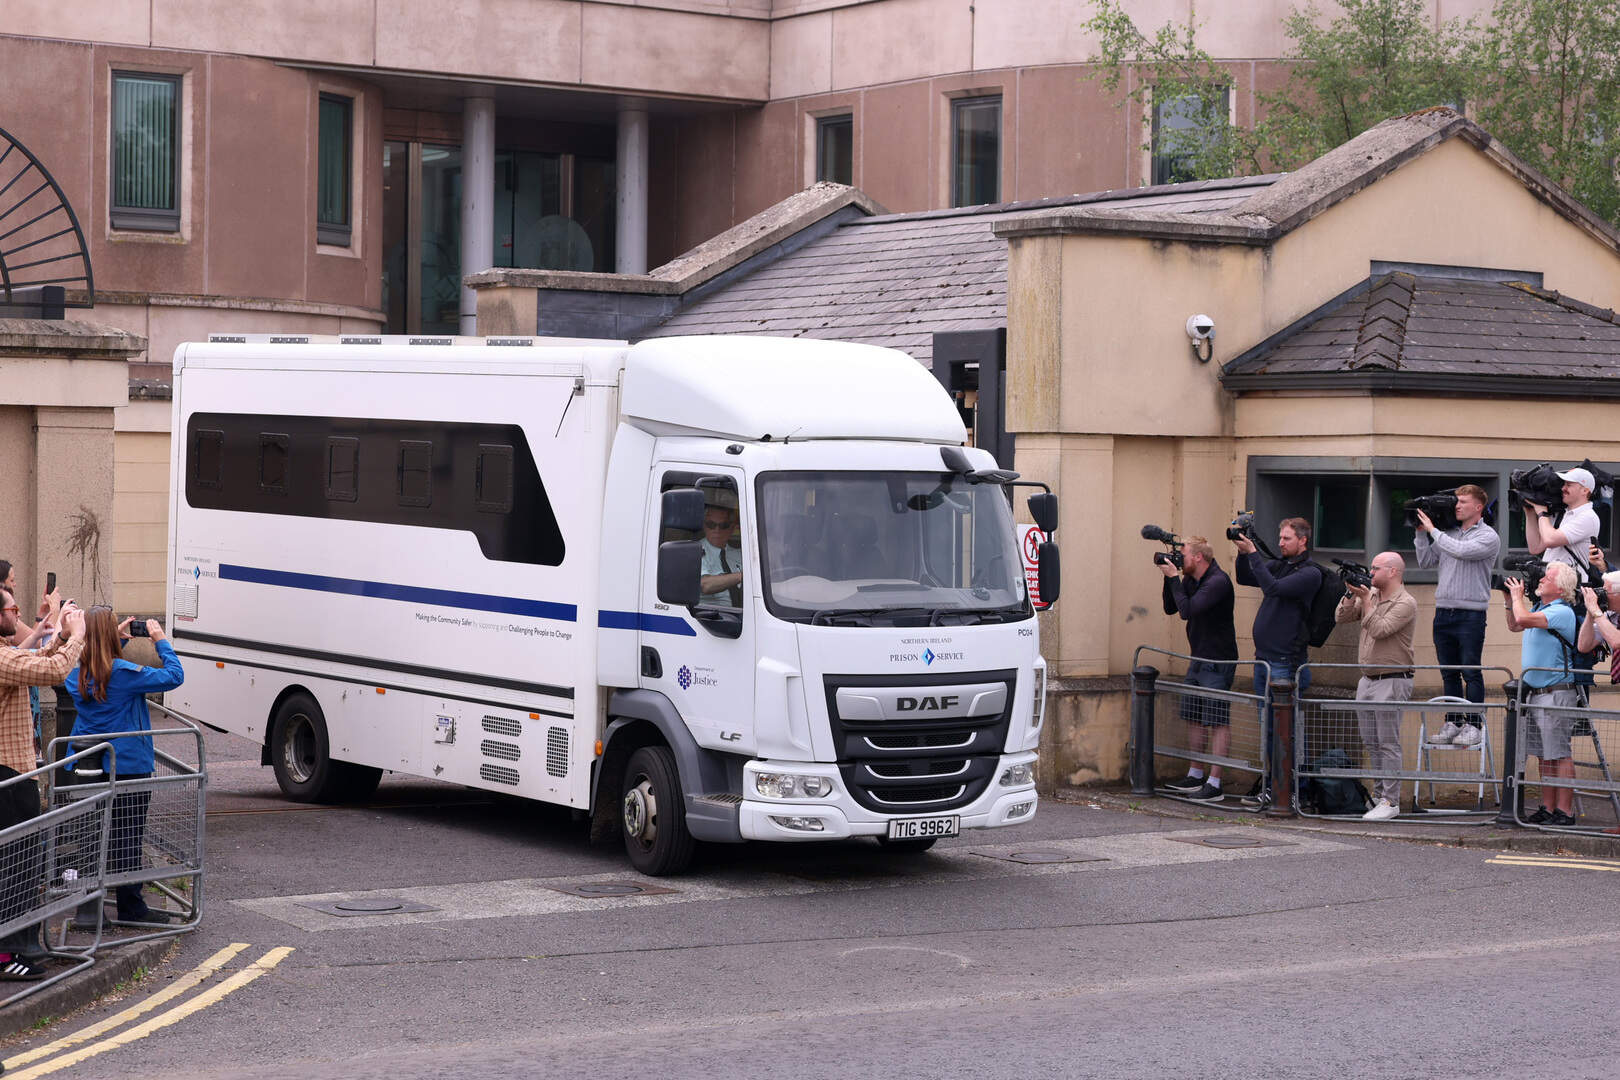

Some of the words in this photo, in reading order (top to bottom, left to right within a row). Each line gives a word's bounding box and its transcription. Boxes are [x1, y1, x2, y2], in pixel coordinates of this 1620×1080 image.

[416, 613, 430, 623] Making
[438, 615, 460, 626] Community
[462, 618, 472, 626] Safer
[509, 624, 533, 636] Challenging
[534, 627, 549, 637] People
[556, 630, 572, 640] Change
[890, 654, 918, 662] PRISON
[937, 652, 963, 661] SERVICE
[693, 672, 718, 687] Justice
[896, 696, 959, 711] DAF
[720, 731, 742, 741] LF
[897, 822, 917, 837] TIG
[920, 819, 953, 835] 9962
